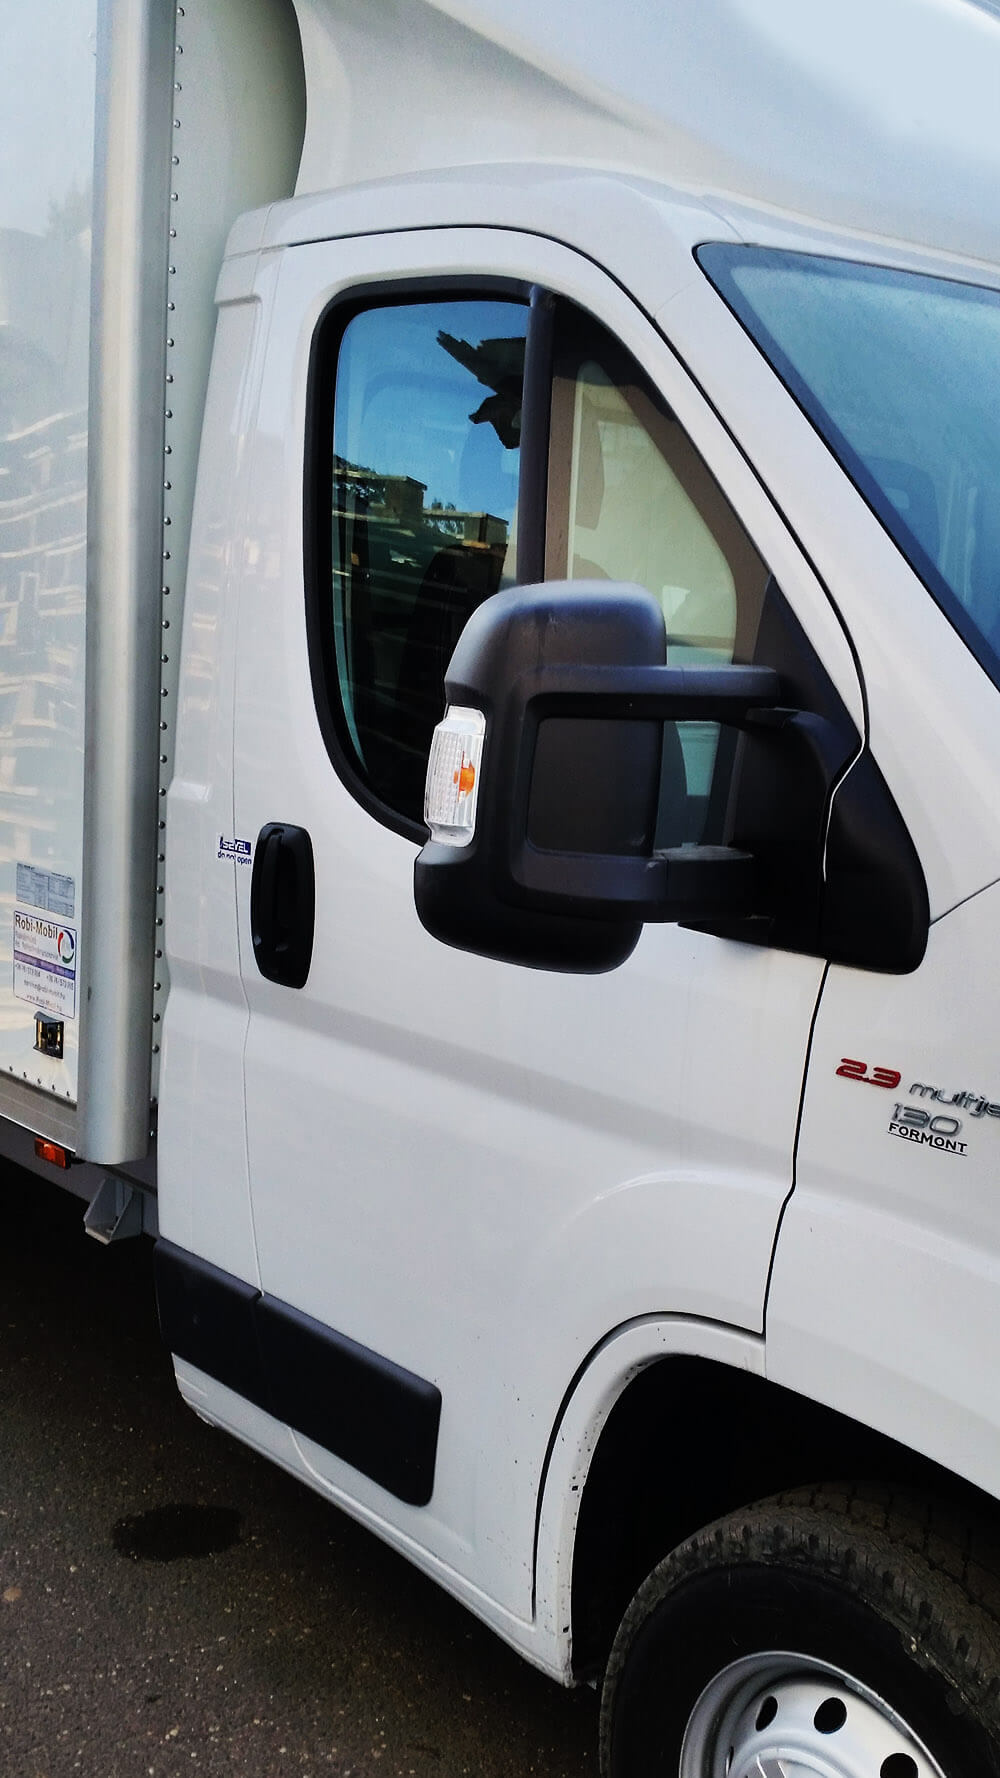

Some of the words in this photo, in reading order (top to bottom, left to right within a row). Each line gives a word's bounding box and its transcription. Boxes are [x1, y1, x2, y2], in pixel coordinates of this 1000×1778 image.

[218, 850, 225, 858] do
[237, 856, 252, 865] open
[15, 914, 58, 939] Robi-Mobil
[893, 1103, 960, 1135] 130
[888, 1122, 968, 1152] FORMONT
